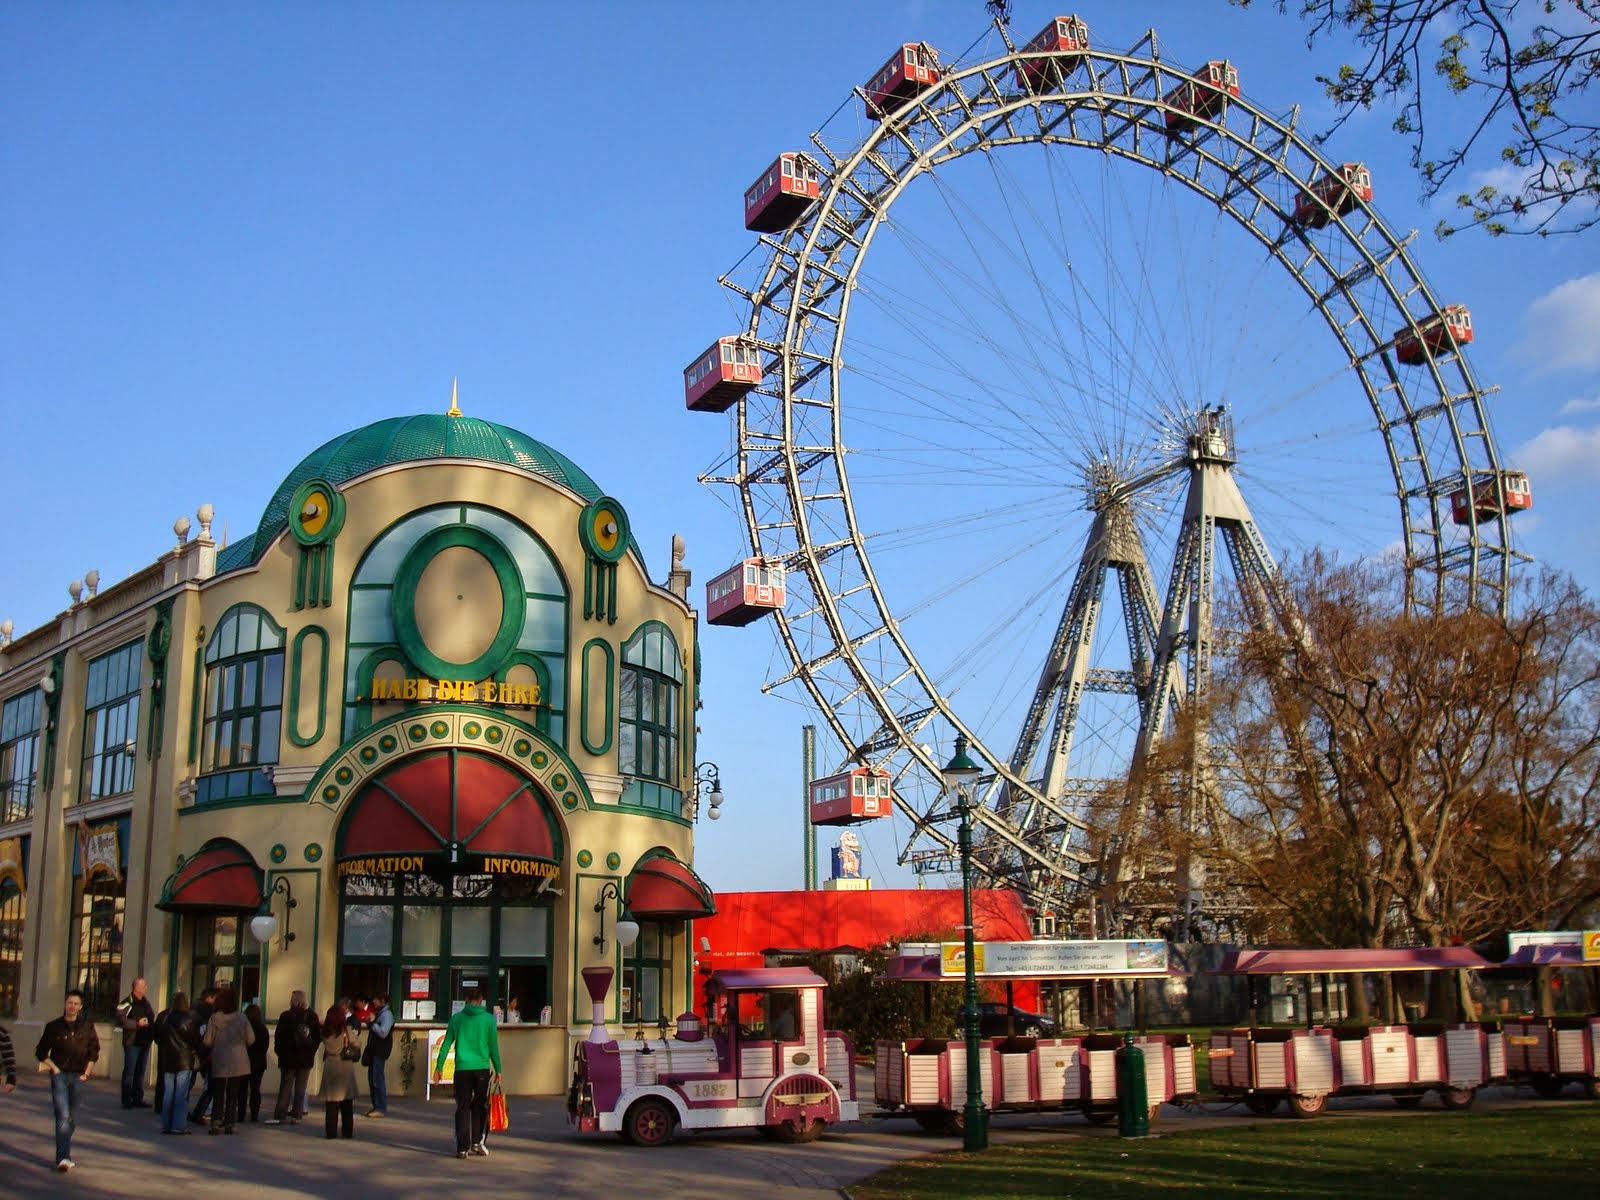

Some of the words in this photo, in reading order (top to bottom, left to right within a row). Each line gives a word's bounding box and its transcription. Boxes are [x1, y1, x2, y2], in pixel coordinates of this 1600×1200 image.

[371, 678, 430, 699] HABE
[438, 679, 476, 701] DIE
[484, 681, 542, 705] EHRE
[338, 856, 424, 877] INFORMATION
[694, 1084, 728, 1097] 1887
